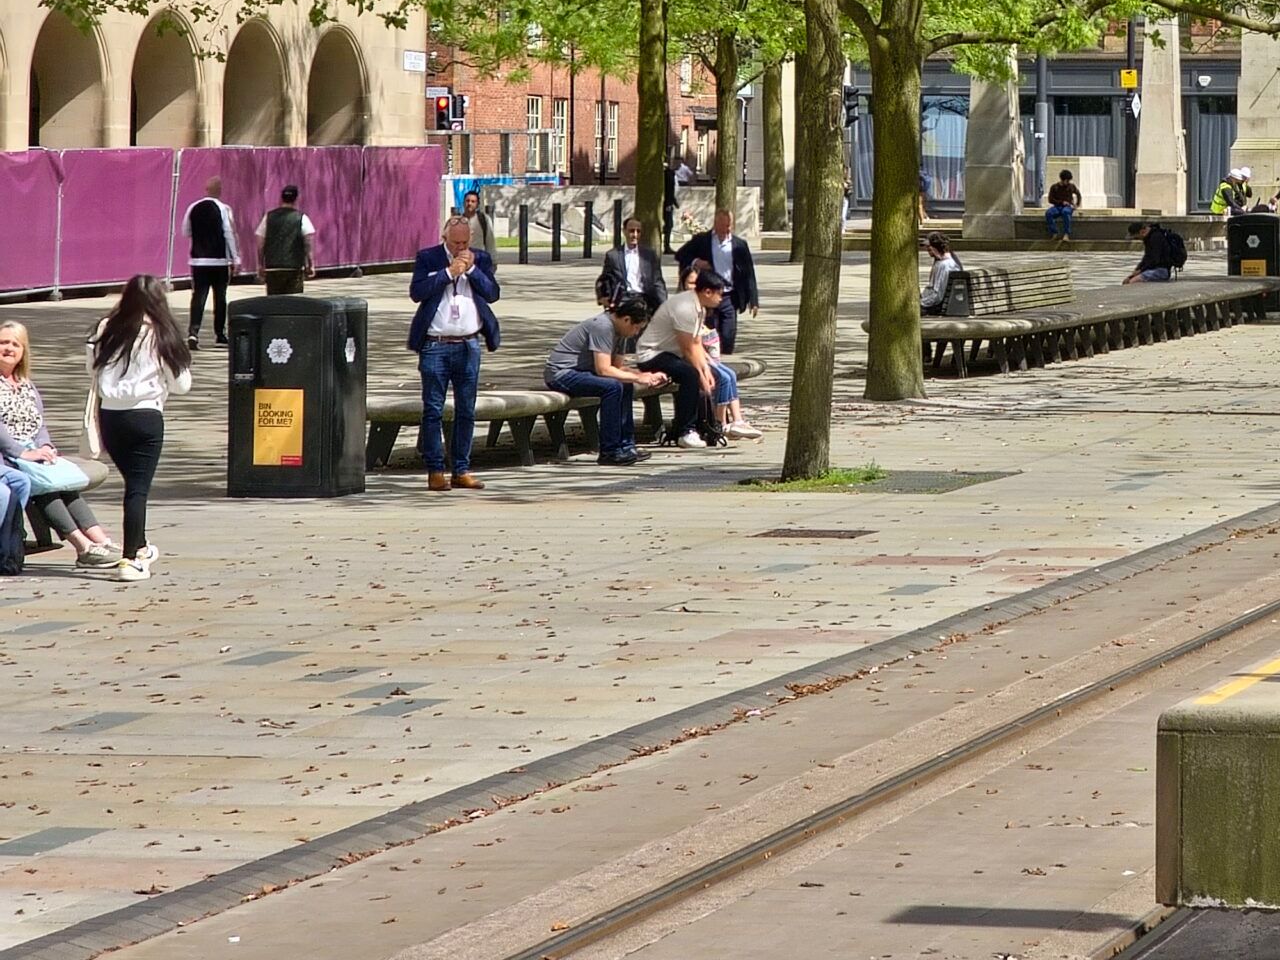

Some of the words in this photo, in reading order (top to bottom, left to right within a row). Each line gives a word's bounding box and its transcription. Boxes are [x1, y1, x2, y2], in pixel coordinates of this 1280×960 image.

[258, 402, 272, 410] BIN
[258, 410, 294, 418] LOOKING
[258, 417, 275, 425] FOR
